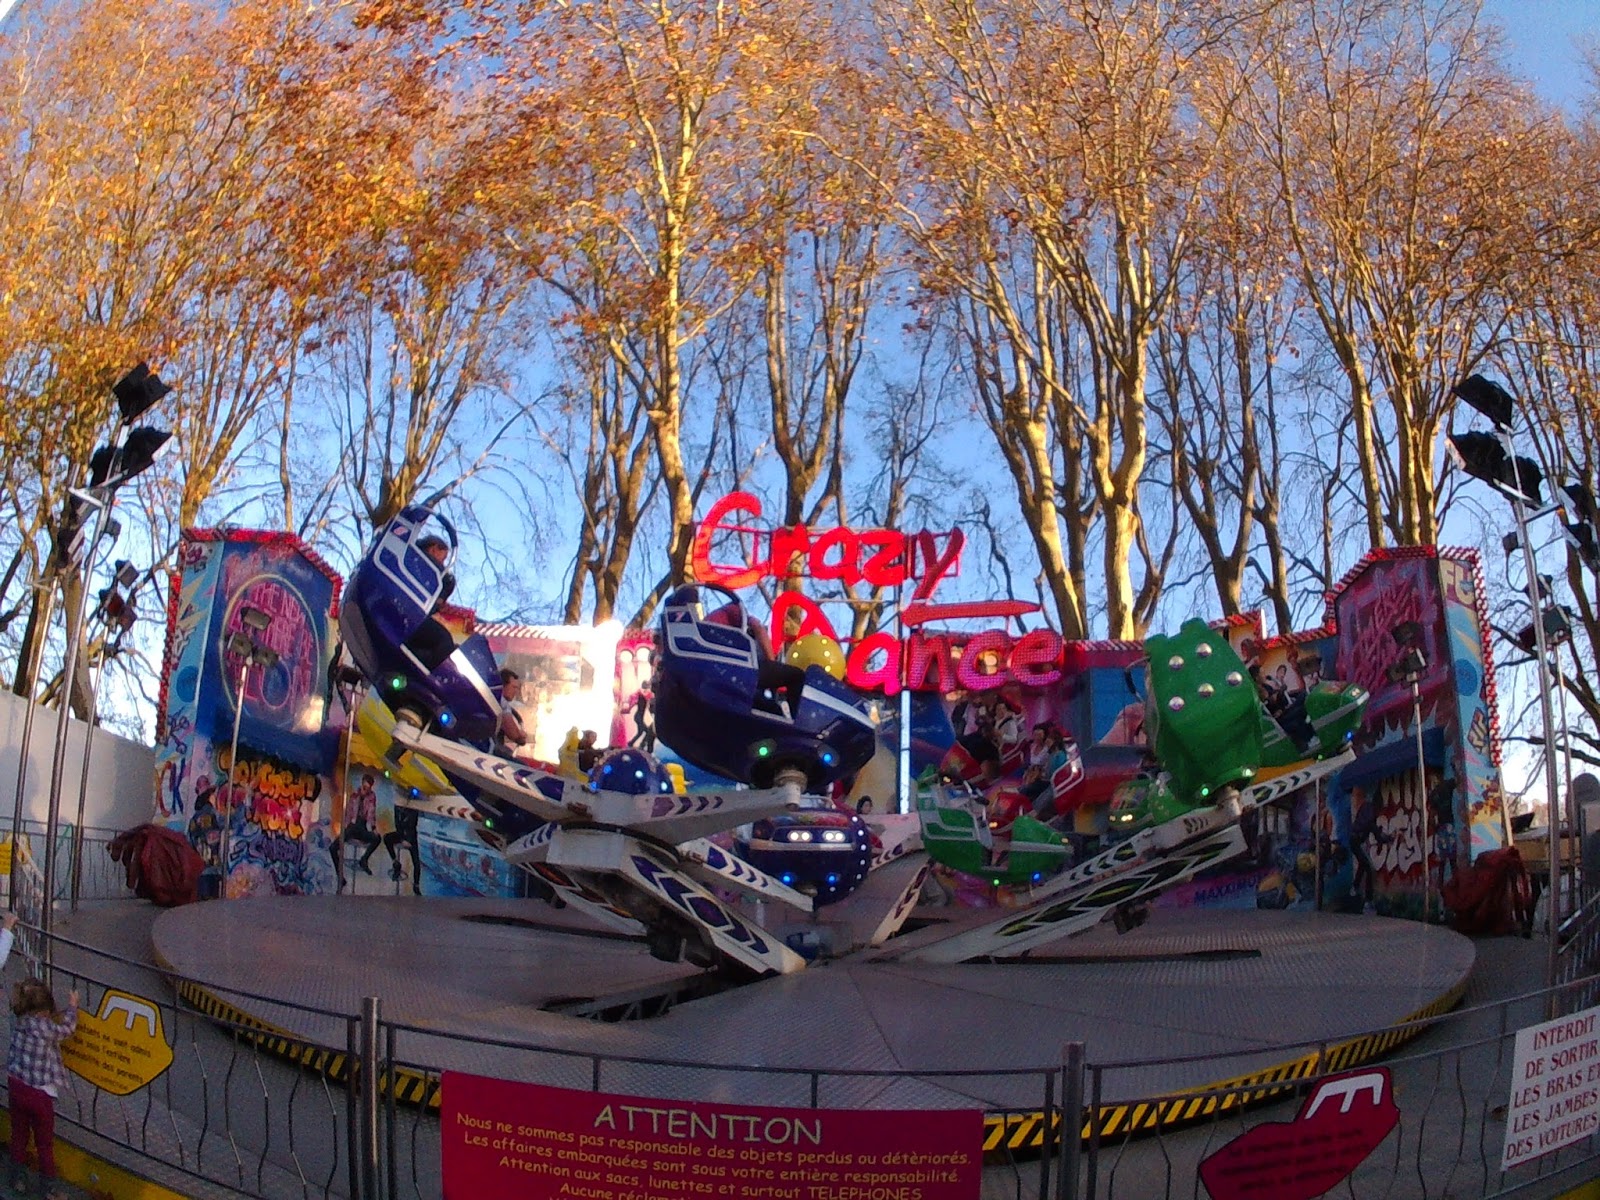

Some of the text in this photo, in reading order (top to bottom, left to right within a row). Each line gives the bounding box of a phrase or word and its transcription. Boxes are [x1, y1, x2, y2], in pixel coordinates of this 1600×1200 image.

[692, 491, 967, 602] Crazy
[770, 590, 1065, 696] Dance
[1533, 1014, 1597, 1050] INTERDIT
[1524, 1039, 1598, 1081] DE SORTIR
[1513, 1084, 1541, 1109] LES
[1545, 1069, 1583, 1098] BRAS
[1513, 1088, 1598, 1134] LES JAMBES
[456, 1112, 493, 1131] Nous
[496, 1121, 513, 1135] ne
[517, 1125, 574, 1143] sommes
[579, 1133, 605, 1148] pas
[609, 1138, 702, 1159] responsable
[707, 1146, 735, 1160] des
[740, 1148, 793, 1166] objets
[797, 1150, 853, 1167] perdus
[858, 1154, 877, 1166] ou
[593, 1104, 822, 1146] ATTENTION
[1505, 1112, 1598, 1161] DES VOITURES
[464, 1131, 489, 1148] Les
[492, 1138, 553, 1158] affaires
[557, 1149, 648, 1171] embarquées
[652, 1159, 686, 1174] sont
[691, 1165, 726, 1177] sous
[731, 1166, 775, 1181] votre
[780, 1166, 840, 1183] entière
[499, 1155, 571, 1178] Attention
[574, 1168, 601, 1181] aux
[649, 1175, 713, 1194] lunettes
[718, 1182, 736, 1196] et
[741, 1184, 801, 1200] surtout
[807, 1185, 923, 1200] TELEPHONES
[559, 1182, 614, 1200] Aucune
